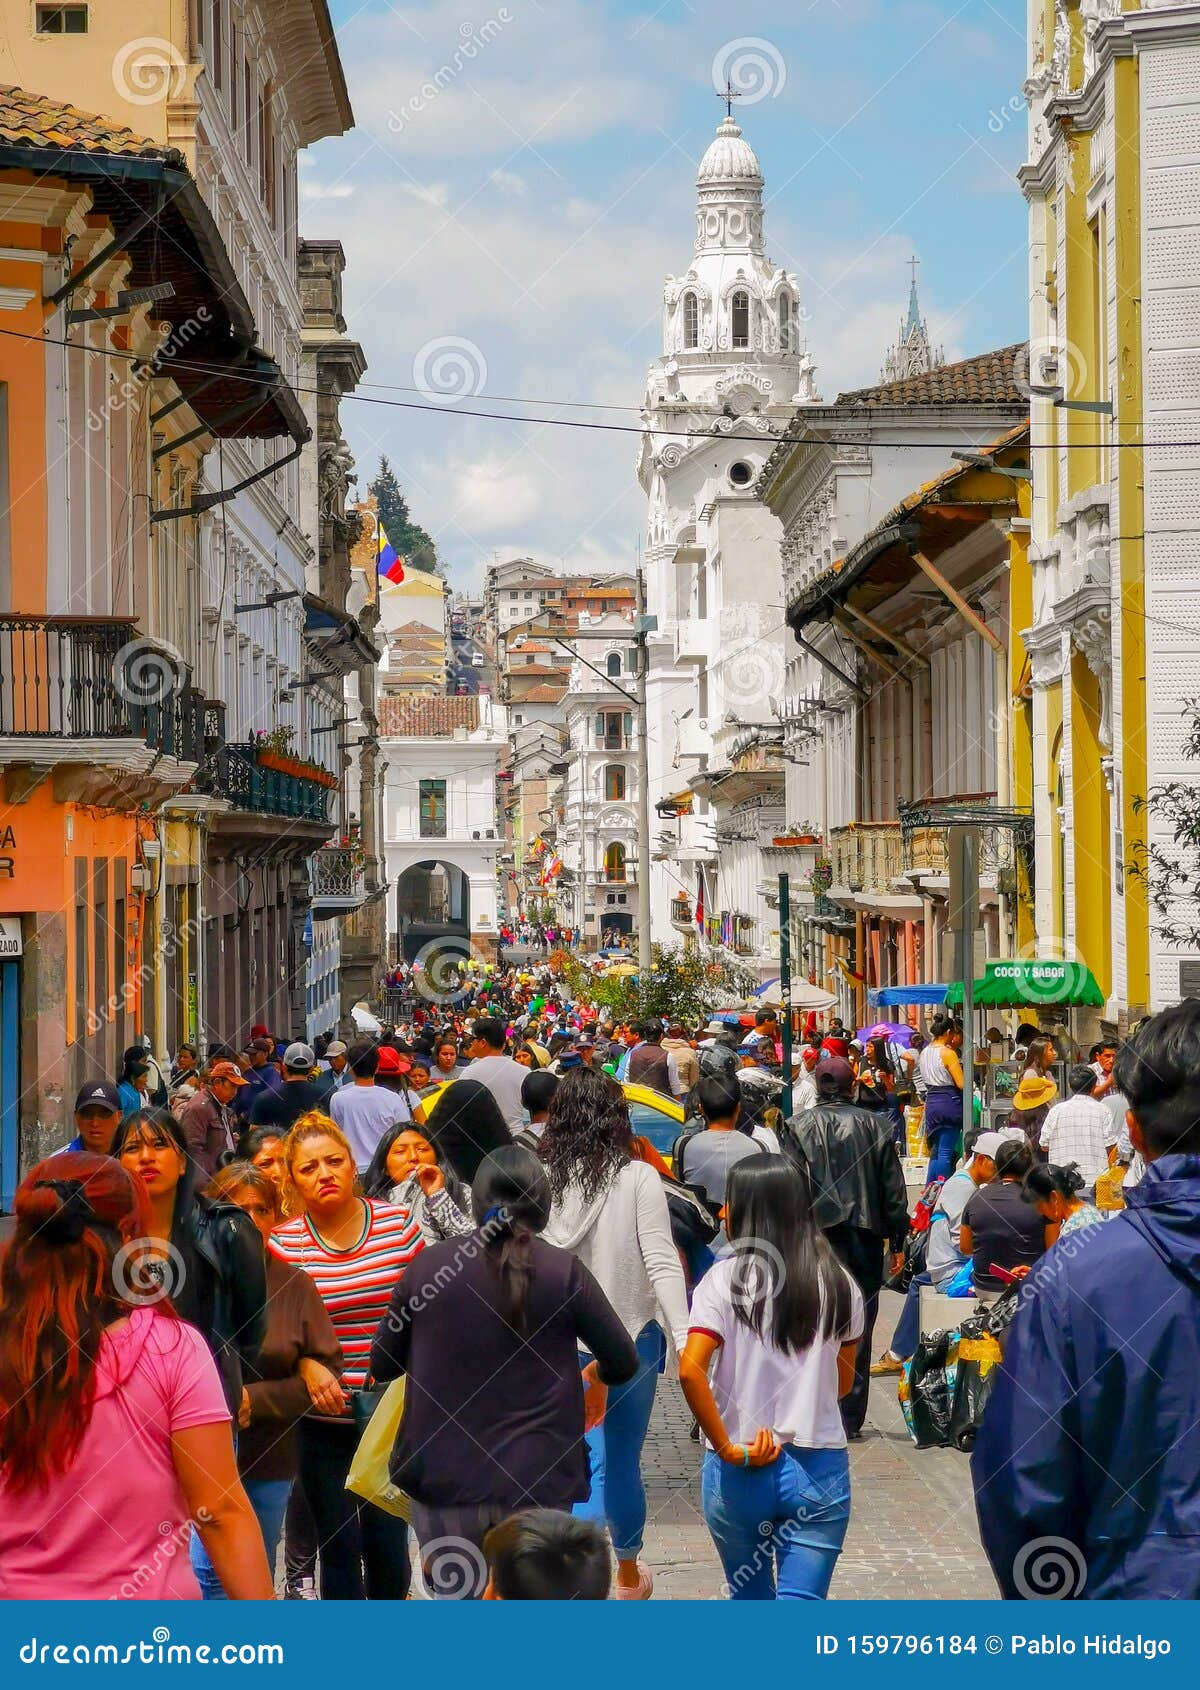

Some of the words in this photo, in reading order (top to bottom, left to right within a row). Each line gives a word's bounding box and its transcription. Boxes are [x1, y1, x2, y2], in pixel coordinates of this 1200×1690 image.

[994, 967, 1021, 978] COCO
[1023, 967, 1030, 978] Y
[1032, 967, 1065, 978] SABOR
